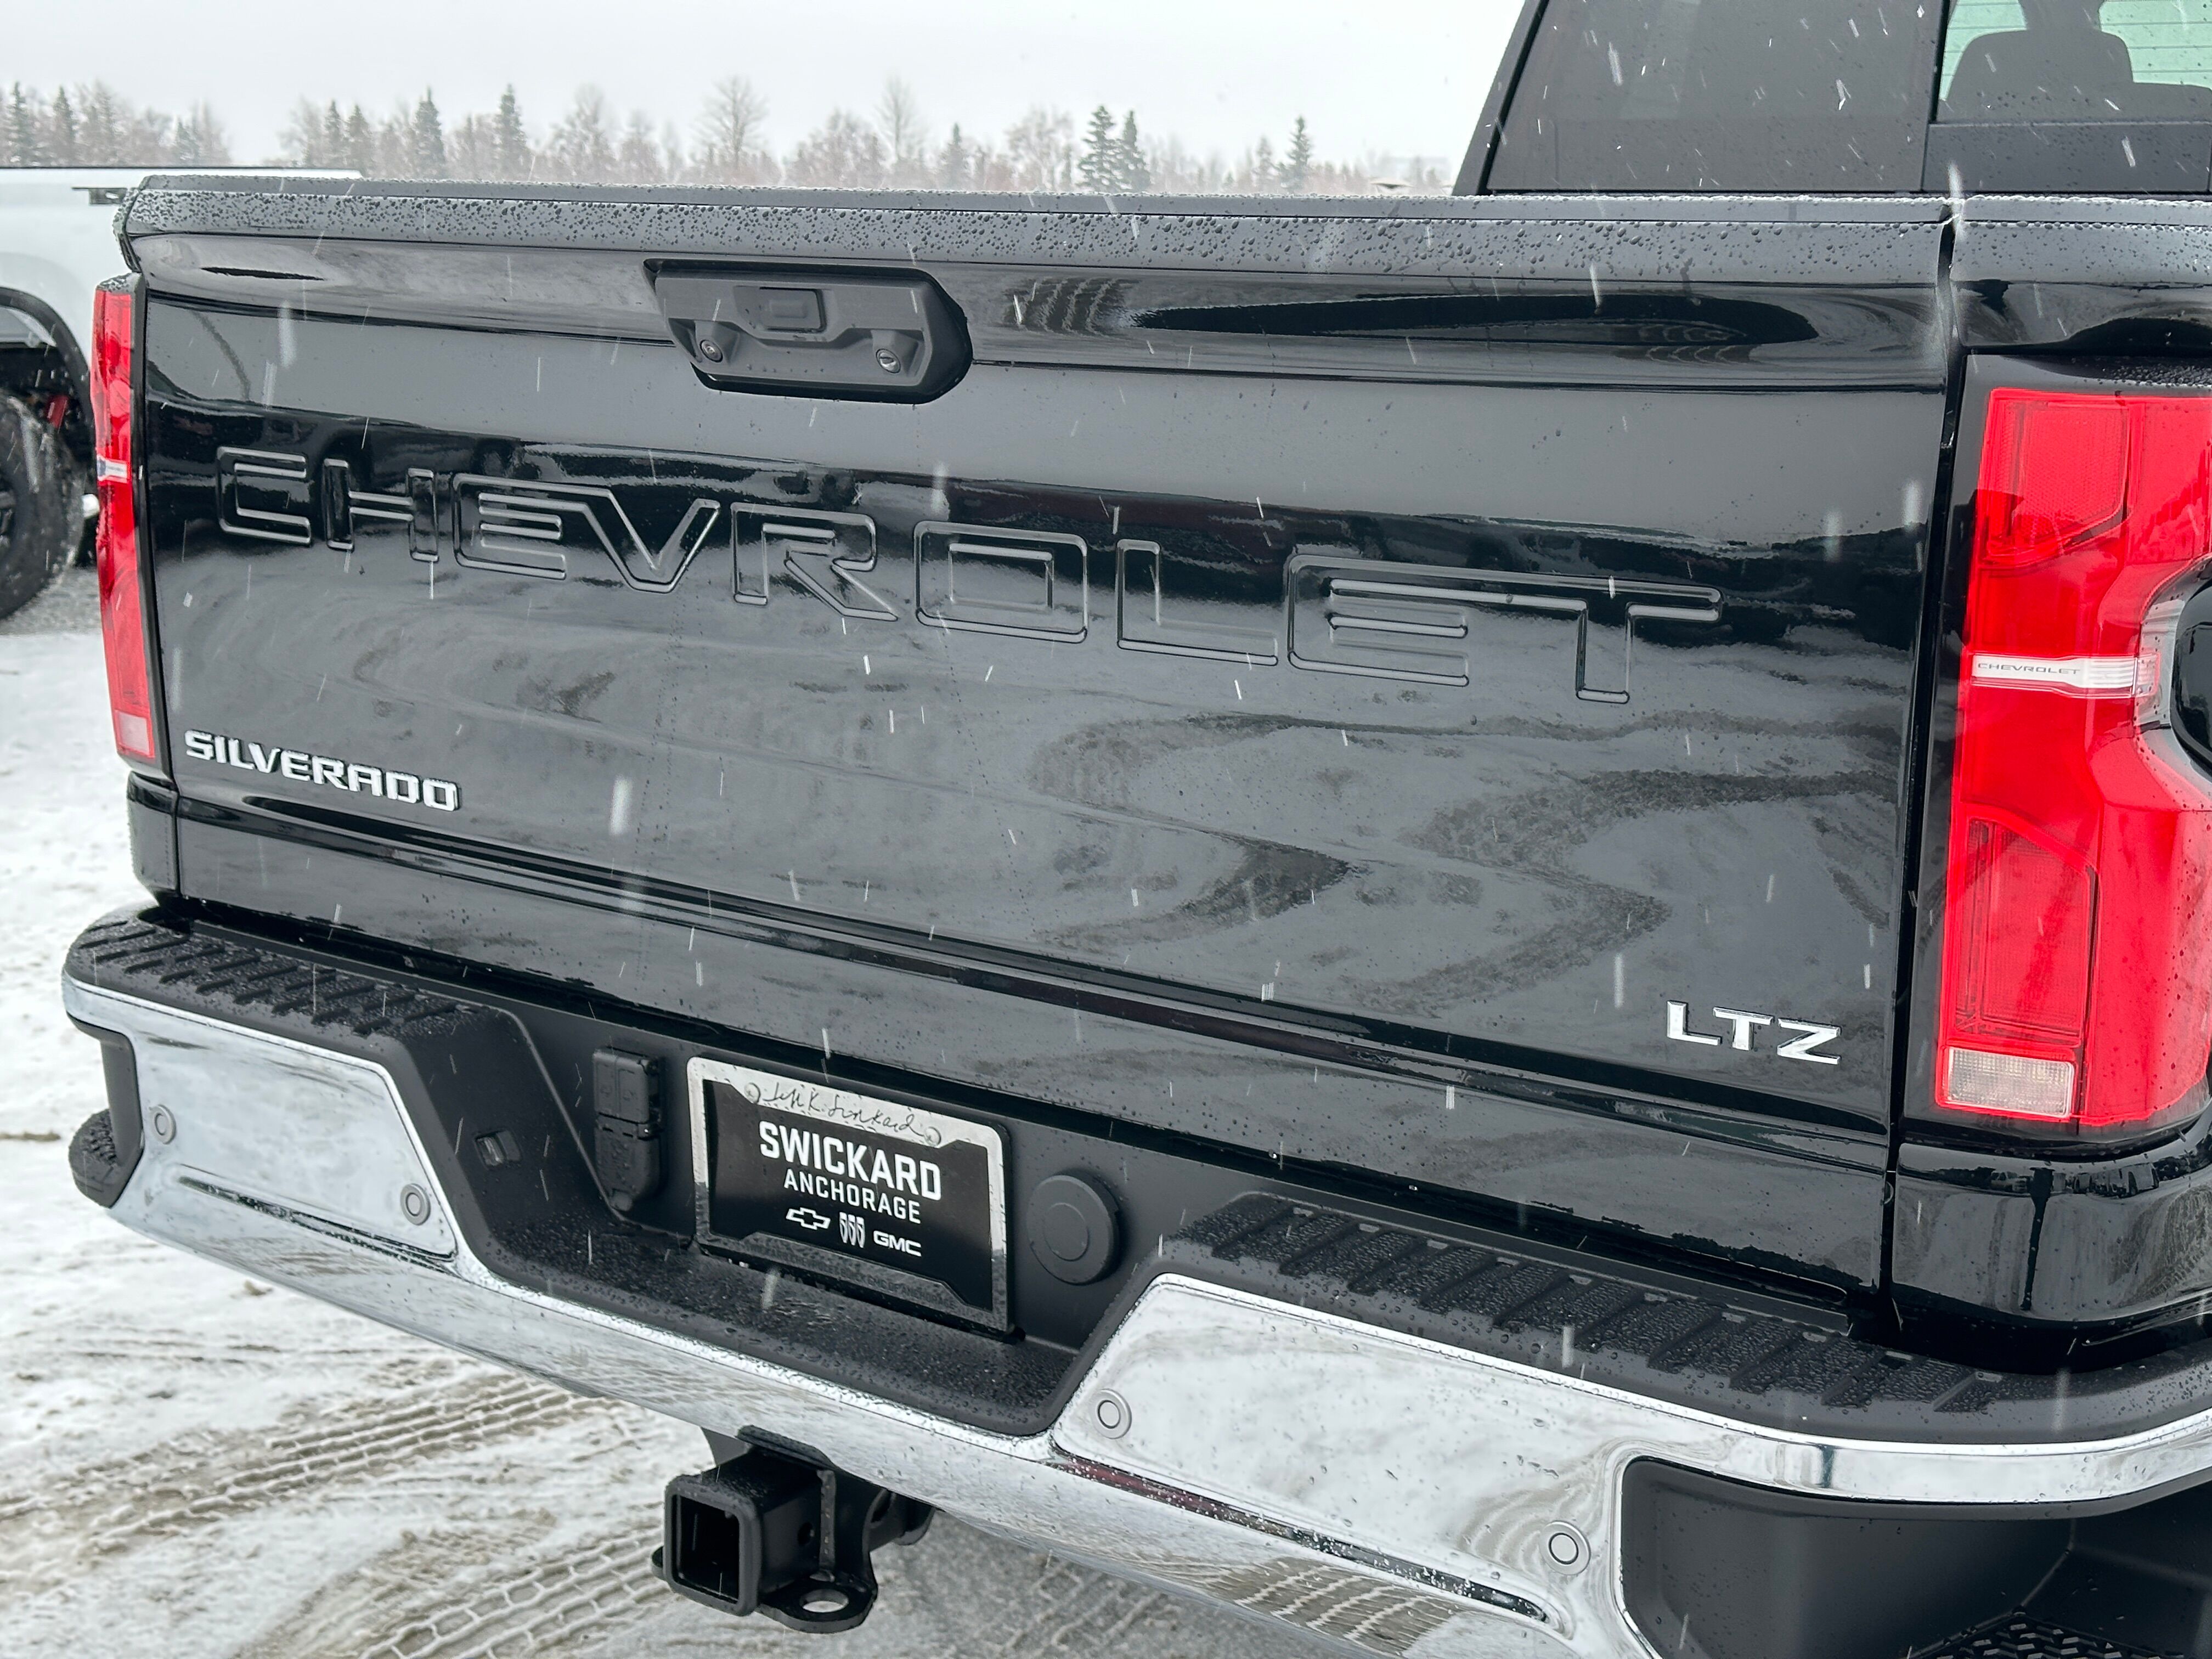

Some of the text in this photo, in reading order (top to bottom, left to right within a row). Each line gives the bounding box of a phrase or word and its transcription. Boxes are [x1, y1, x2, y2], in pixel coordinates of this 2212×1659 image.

[216, 446, 1722, 704] CHEVROLET
[1977, 663, 2080, 675] CHEVROLET
[184, 729, 460, 811] SILVERADO
[1667, 1000, 1841, 1065] LTZ
[759, 1120, 941, 1201] SWICKARD
[783, 1169, 921, 1224] ANCHORAGE
[873, 1231, 922, 1256] GMC
